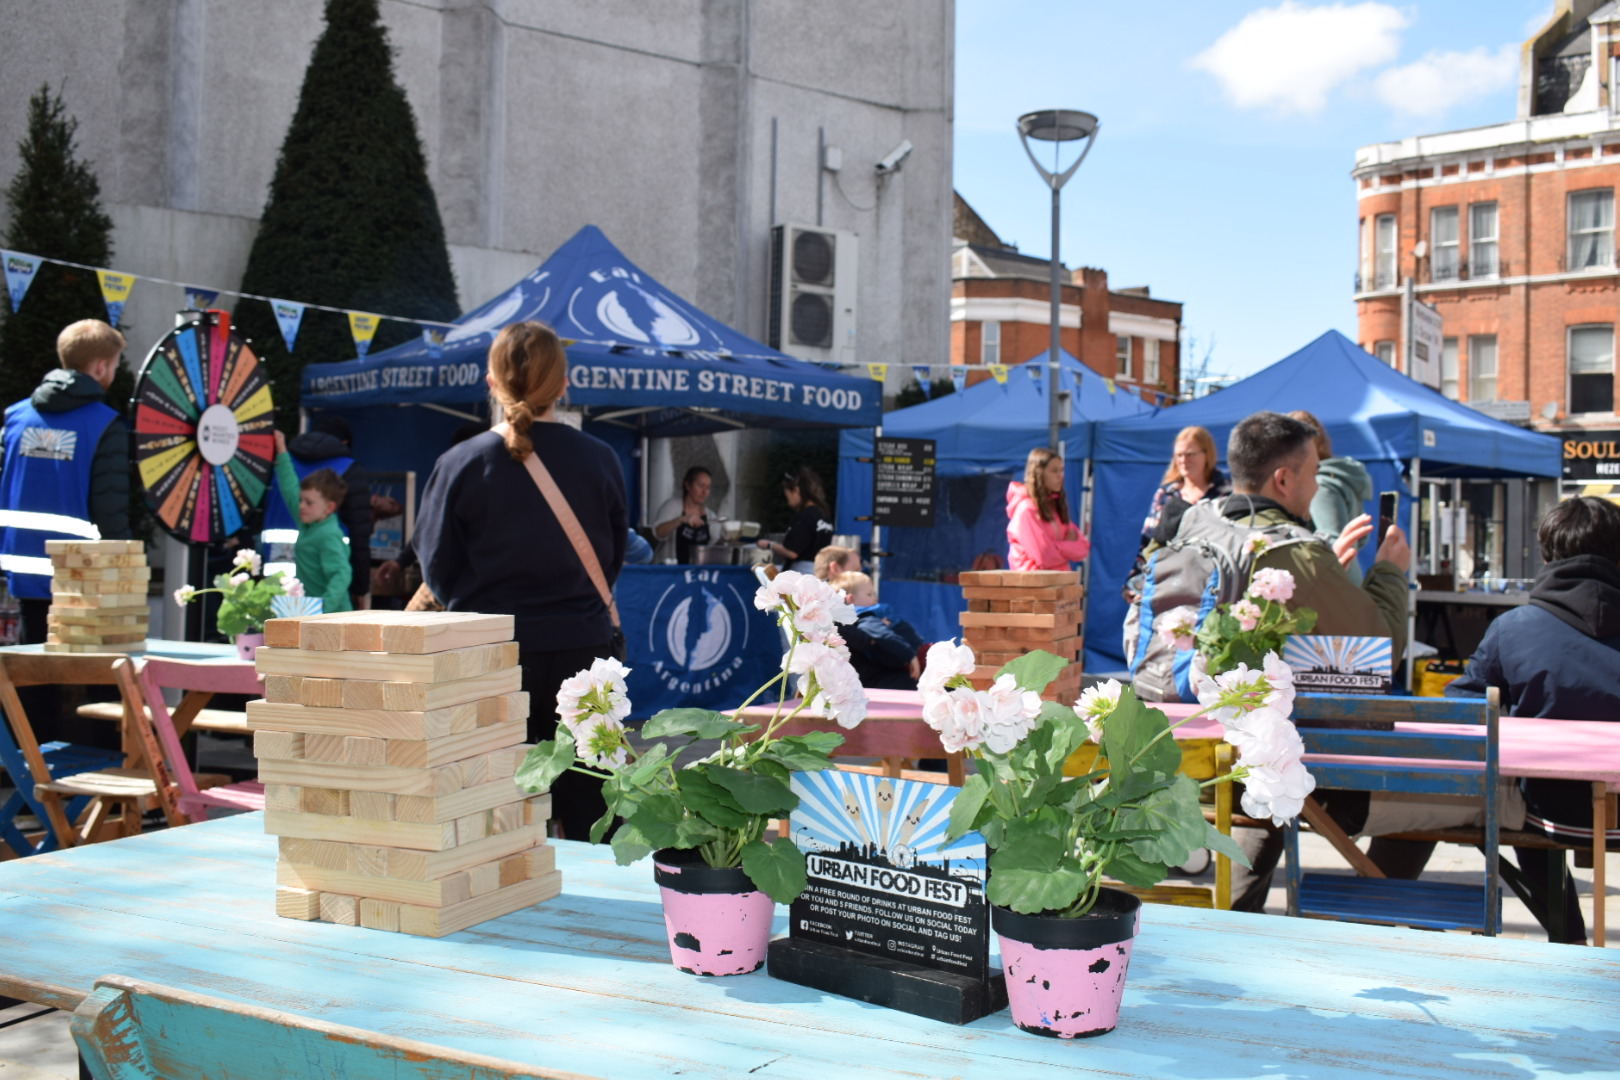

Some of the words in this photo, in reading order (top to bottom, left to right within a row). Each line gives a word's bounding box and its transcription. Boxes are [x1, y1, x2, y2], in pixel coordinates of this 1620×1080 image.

[589, 266, 642, 284] Eat
[381, 366, 435, 388] STREET
[438, 363, 480, 387] FOOD
[569, 365, 690, 391] GENTINE
[697, 369, 795, 403] STREET
[802, 384, 862, 411] FOOD
[1563, 440, 1620, 459] SOUL
[684, 569, 720, 584] Eat
[652, 656, 743, 694] Argentina
[1295, 674, 1328, 684] URBAN
[1329, 675, 1358, 685] FOOD
[1359, 677, 1380, 686] FEST
[811, 857, 868, 885] URBAN
[870, 868, 921, 895] FOOD
[924, 879, 962, 902] FEST
[800, 893, 810, 901] OR
[811, 895, 824, 903] YOU
[825, 898, 839, 906] AND
[844, 902, 874, 914] FRIENDS.
[875, 908, 903, 920] FOLLOW
[904, 914, 914, 923] US
[915, 916, 925, 925] ON
[926, 920, 952, 931] SOCIAL
[954, 924, 977, 936] TODAY
[810, 904, 819, 912] OR
[820, 906, 837, 916] POST
[838, 910, 856, 920] YOUR
[857, 914, 880, 925] PHOTO
[881, 919, 891, 928] ON
[892, 921, 916, 933] SOCIAL
[918, 927, 932, 937] AND
[934, 930, 948, 940] TAG
[949, 933, 962, 943] US!
[820, 887, 836, 897] FREE
[837, 891, 860, 901] ROUND
[872, 897, 897, 909] DRINKS
[897, 903, 906, 911] AT
[907, 905, 932, 916] URBAN
[933, 910, 953, 921] FOOD
[954, 915, 972, 924] FEST
